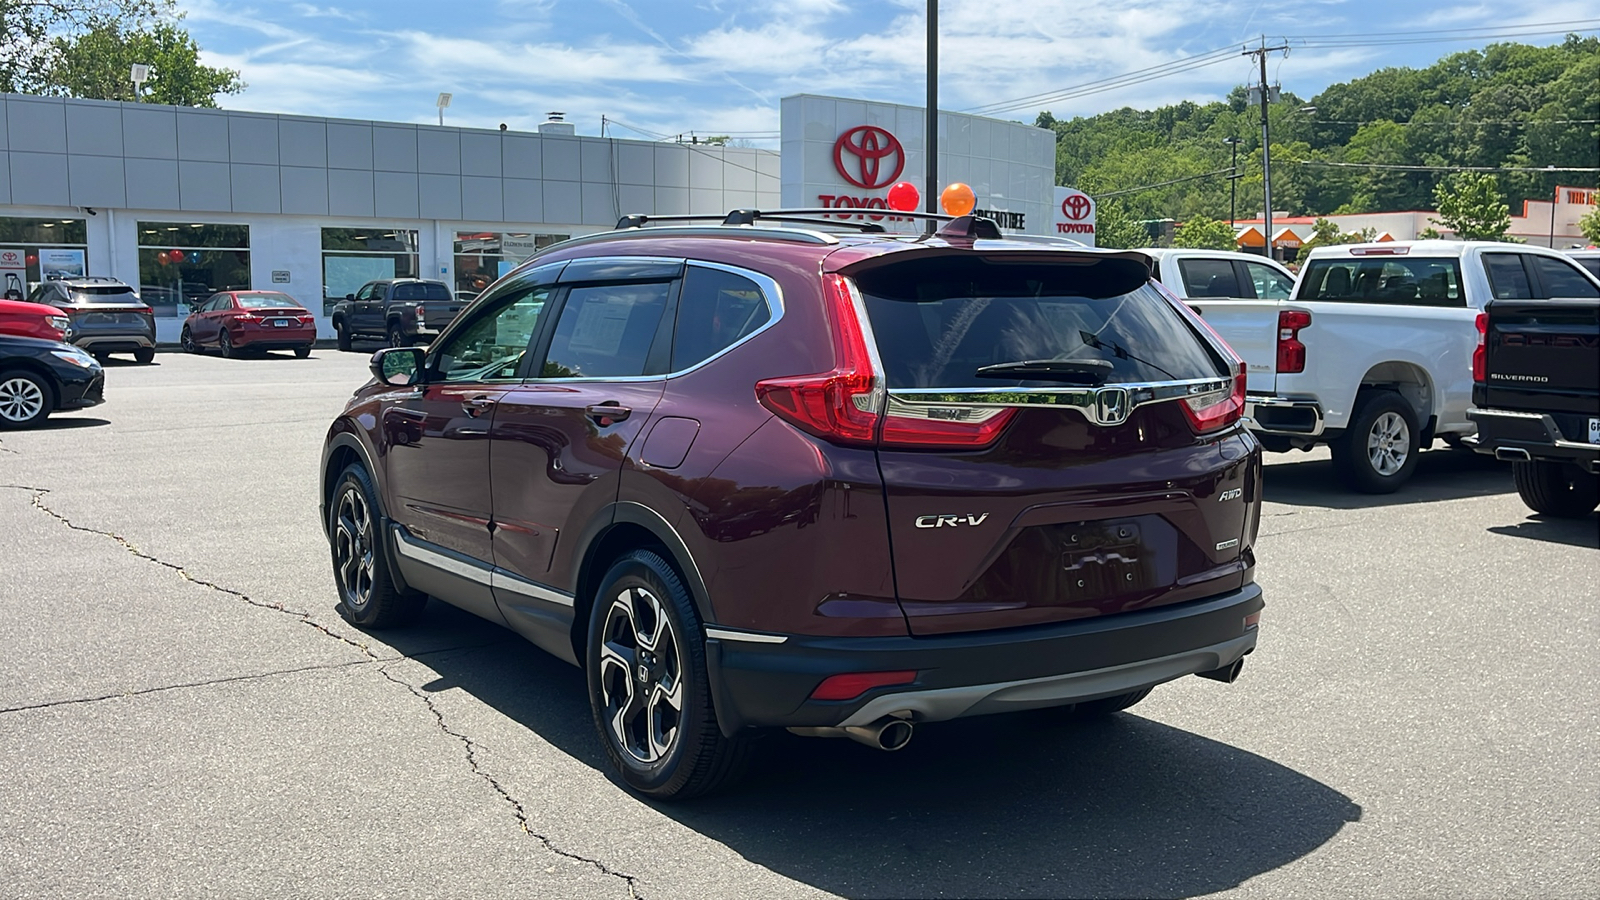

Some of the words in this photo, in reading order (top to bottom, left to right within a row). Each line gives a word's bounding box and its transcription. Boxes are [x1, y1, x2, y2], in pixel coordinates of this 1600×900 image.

[1056, 223, 1095, 234] TOYOTA
[1491, 373, 1549, 383] SILVERADO
[1218, 488, 1242, 502] AWD
[915, 512, 990, 528] CR-V
